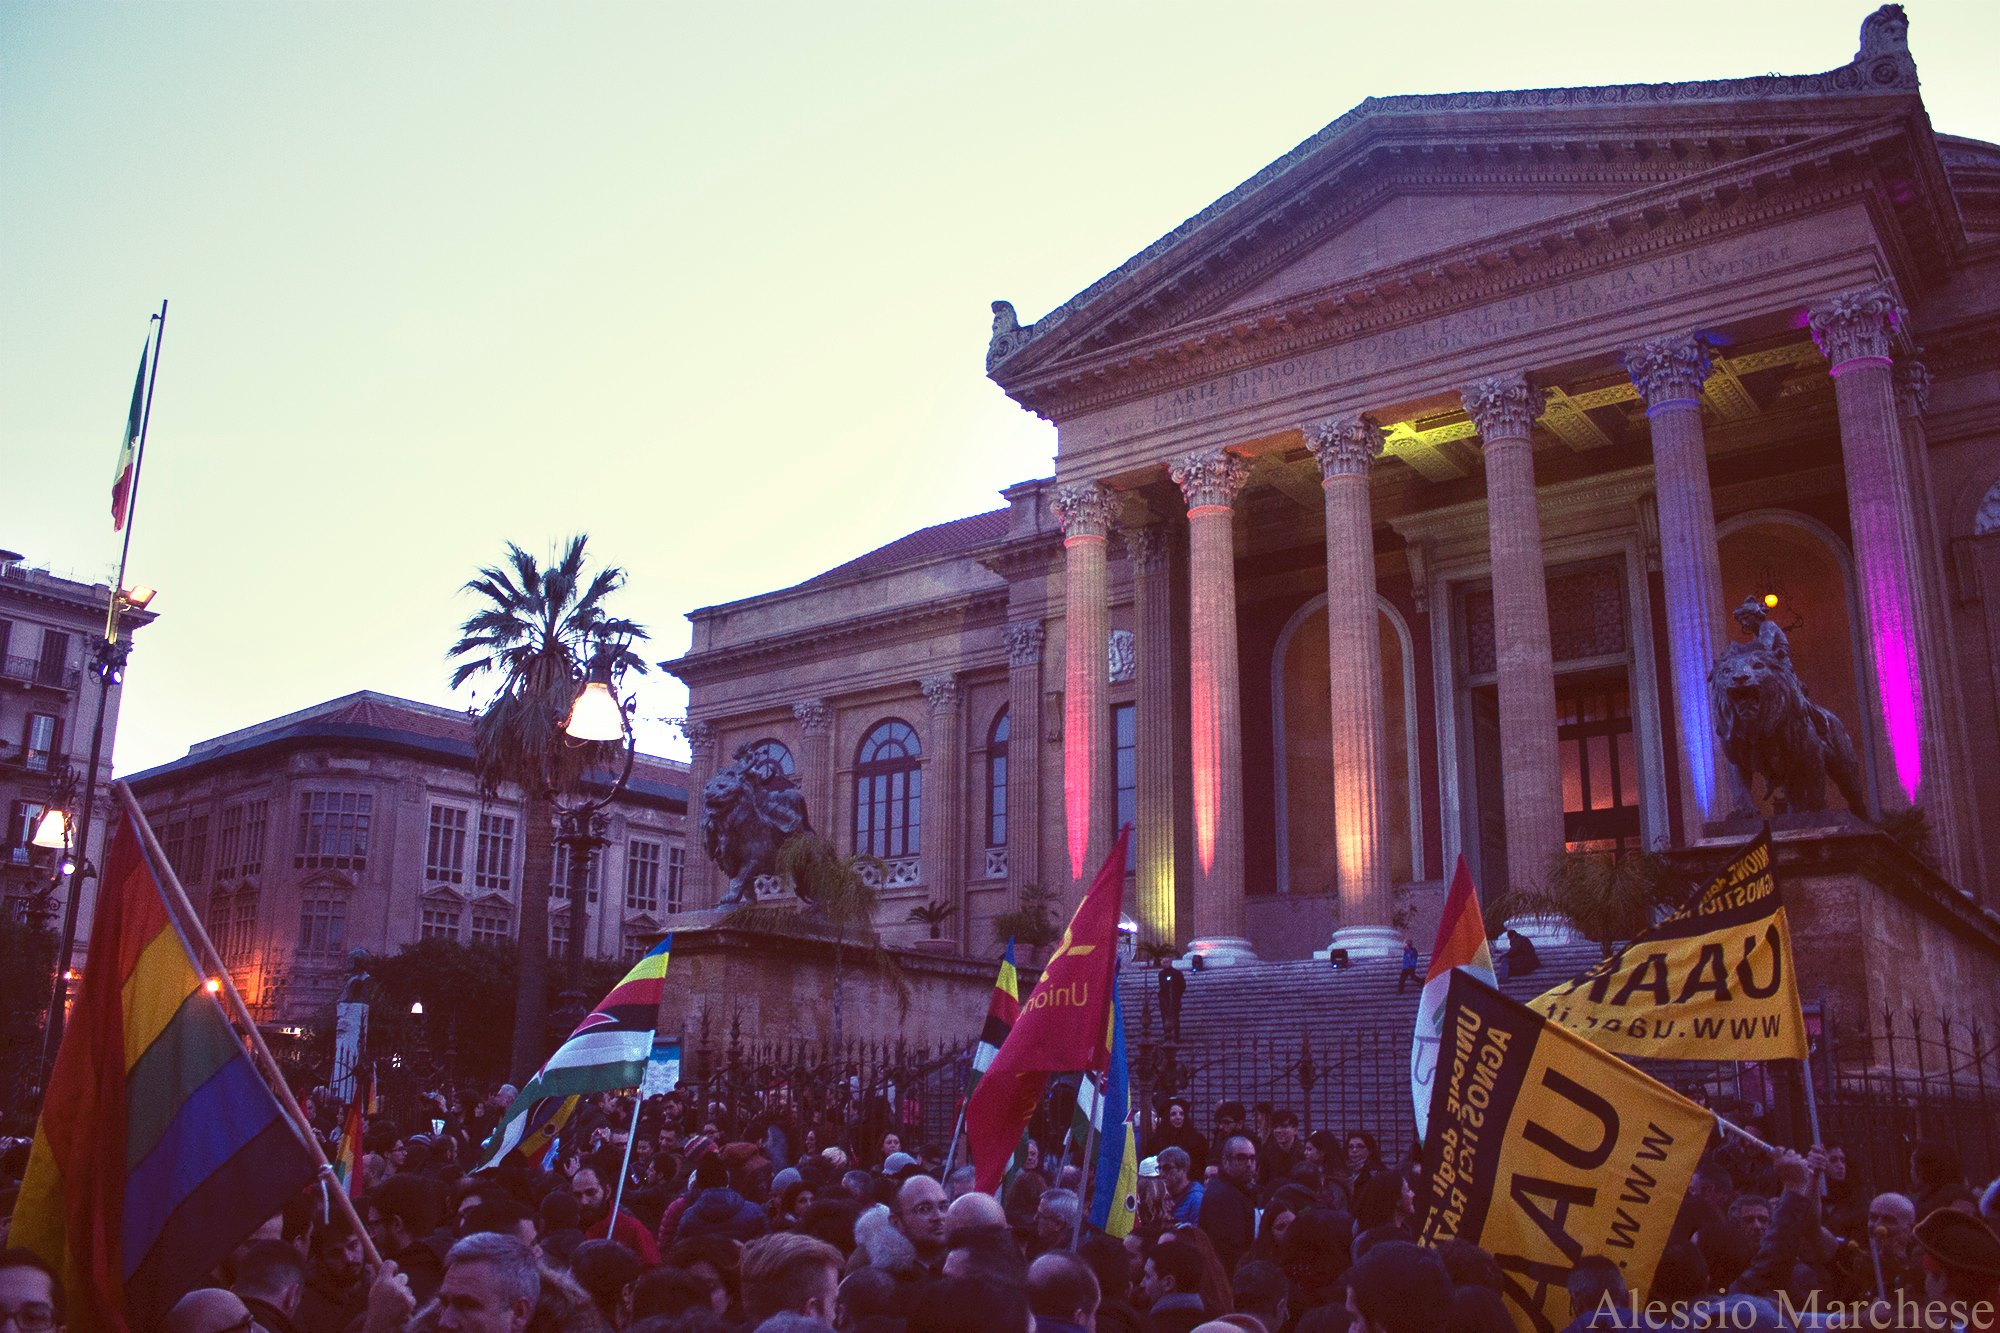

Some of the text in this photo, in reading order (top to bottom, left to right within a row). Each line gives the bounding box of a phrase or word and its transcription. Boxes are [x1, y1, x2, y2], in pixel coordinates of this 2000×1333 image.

[1229, 358, 1322, 391] RINNOVA
[1352, 325, 1428, 358] POPOLI
[1508, 282, 1594, 317] RIVELA
[1610, 271, 1637, 290] LA
[1423, 334, 1463, 353] NON
[1555, 282, 1657, 319] PREPARAR
